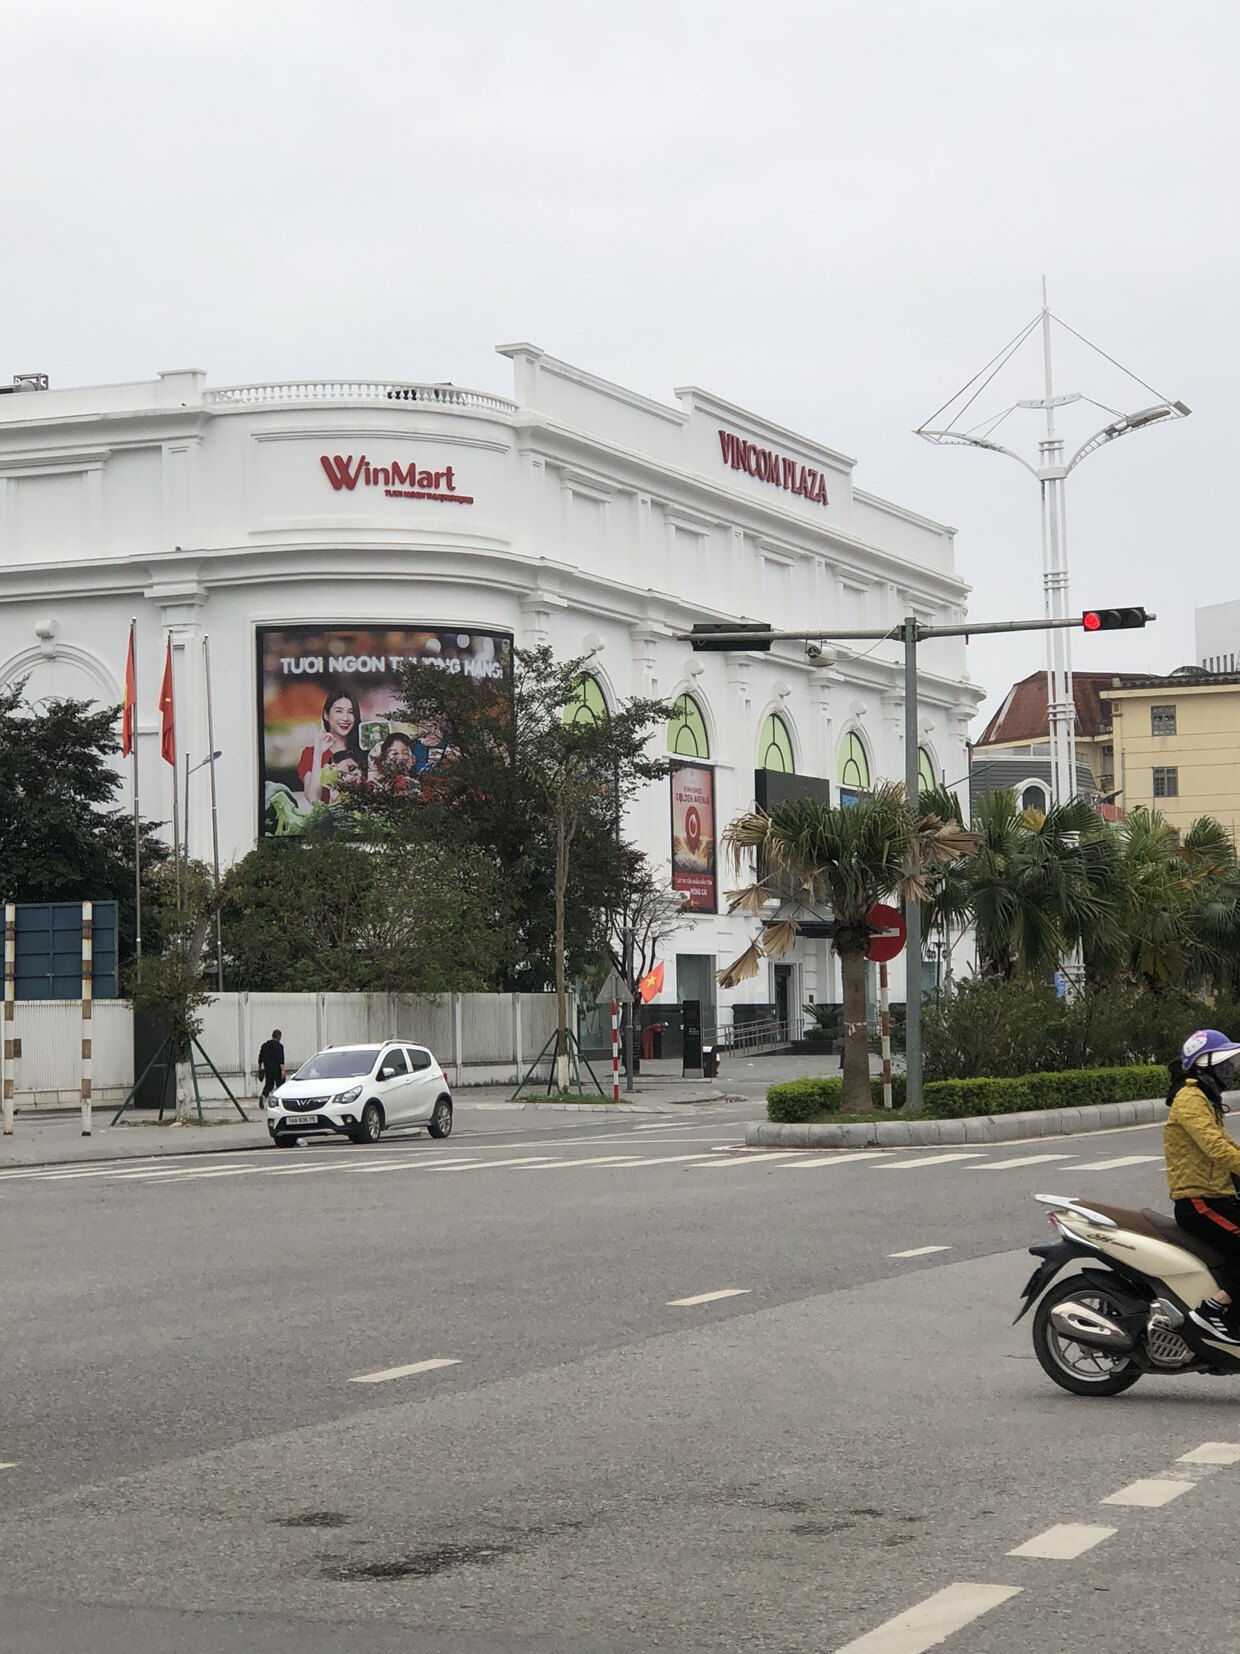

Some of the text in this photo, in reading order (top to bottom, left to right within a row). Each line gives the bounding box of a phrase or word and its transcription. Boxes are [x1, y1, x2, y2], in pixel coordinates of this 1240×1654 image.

[320, 455, 457, 491] WinMart
[718, 429, 830, 506] VINCOM PLAZA
[328, 656, 386, 673] NGON
